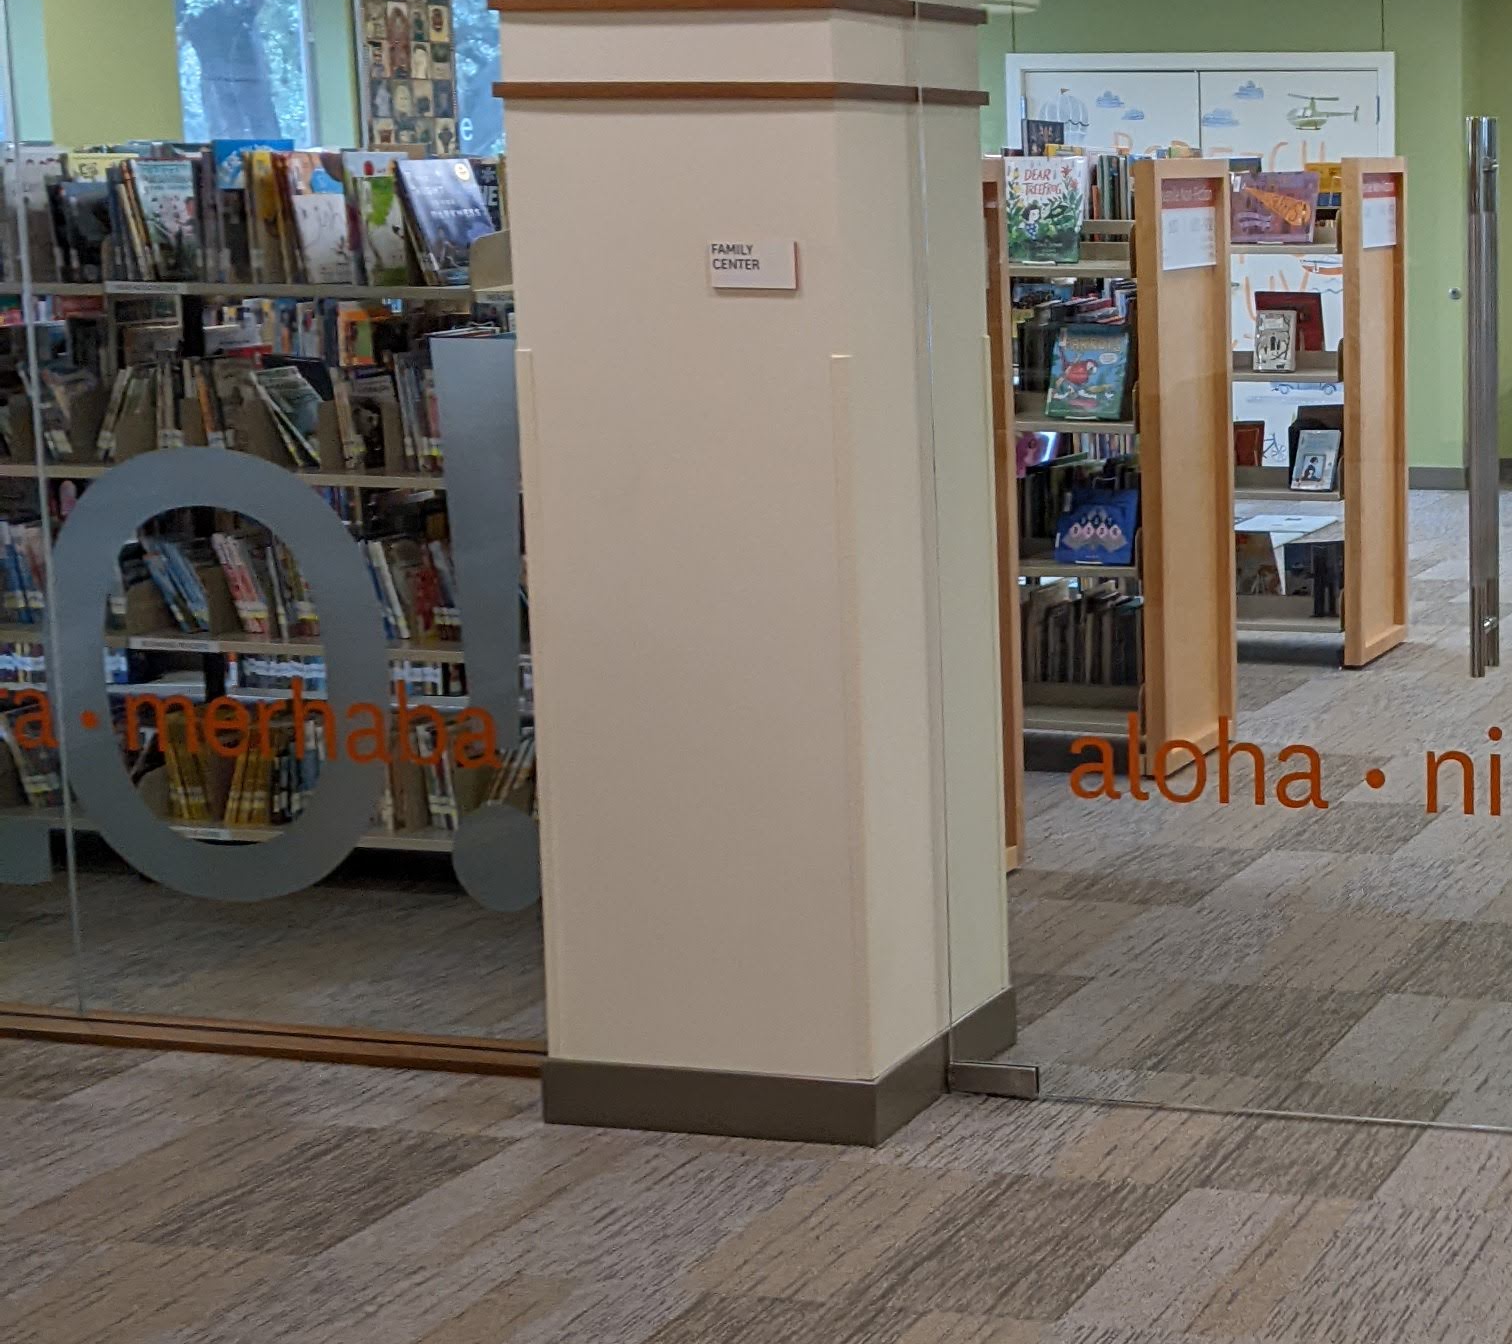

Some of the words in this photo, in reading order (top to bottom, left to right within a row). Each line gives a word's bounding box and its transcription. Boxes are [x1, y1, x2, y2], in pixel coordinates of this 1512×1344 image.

[1023, 168, 1052, 182] DEAR
[711, 243, 754, 256] FAMILY
[712, 258, 761, 271] CENTER
[126, 677, 501, 769] merhaba
[1068, 712, 1330, 810] aloha
[1426, 726, 1504, 817] ni
